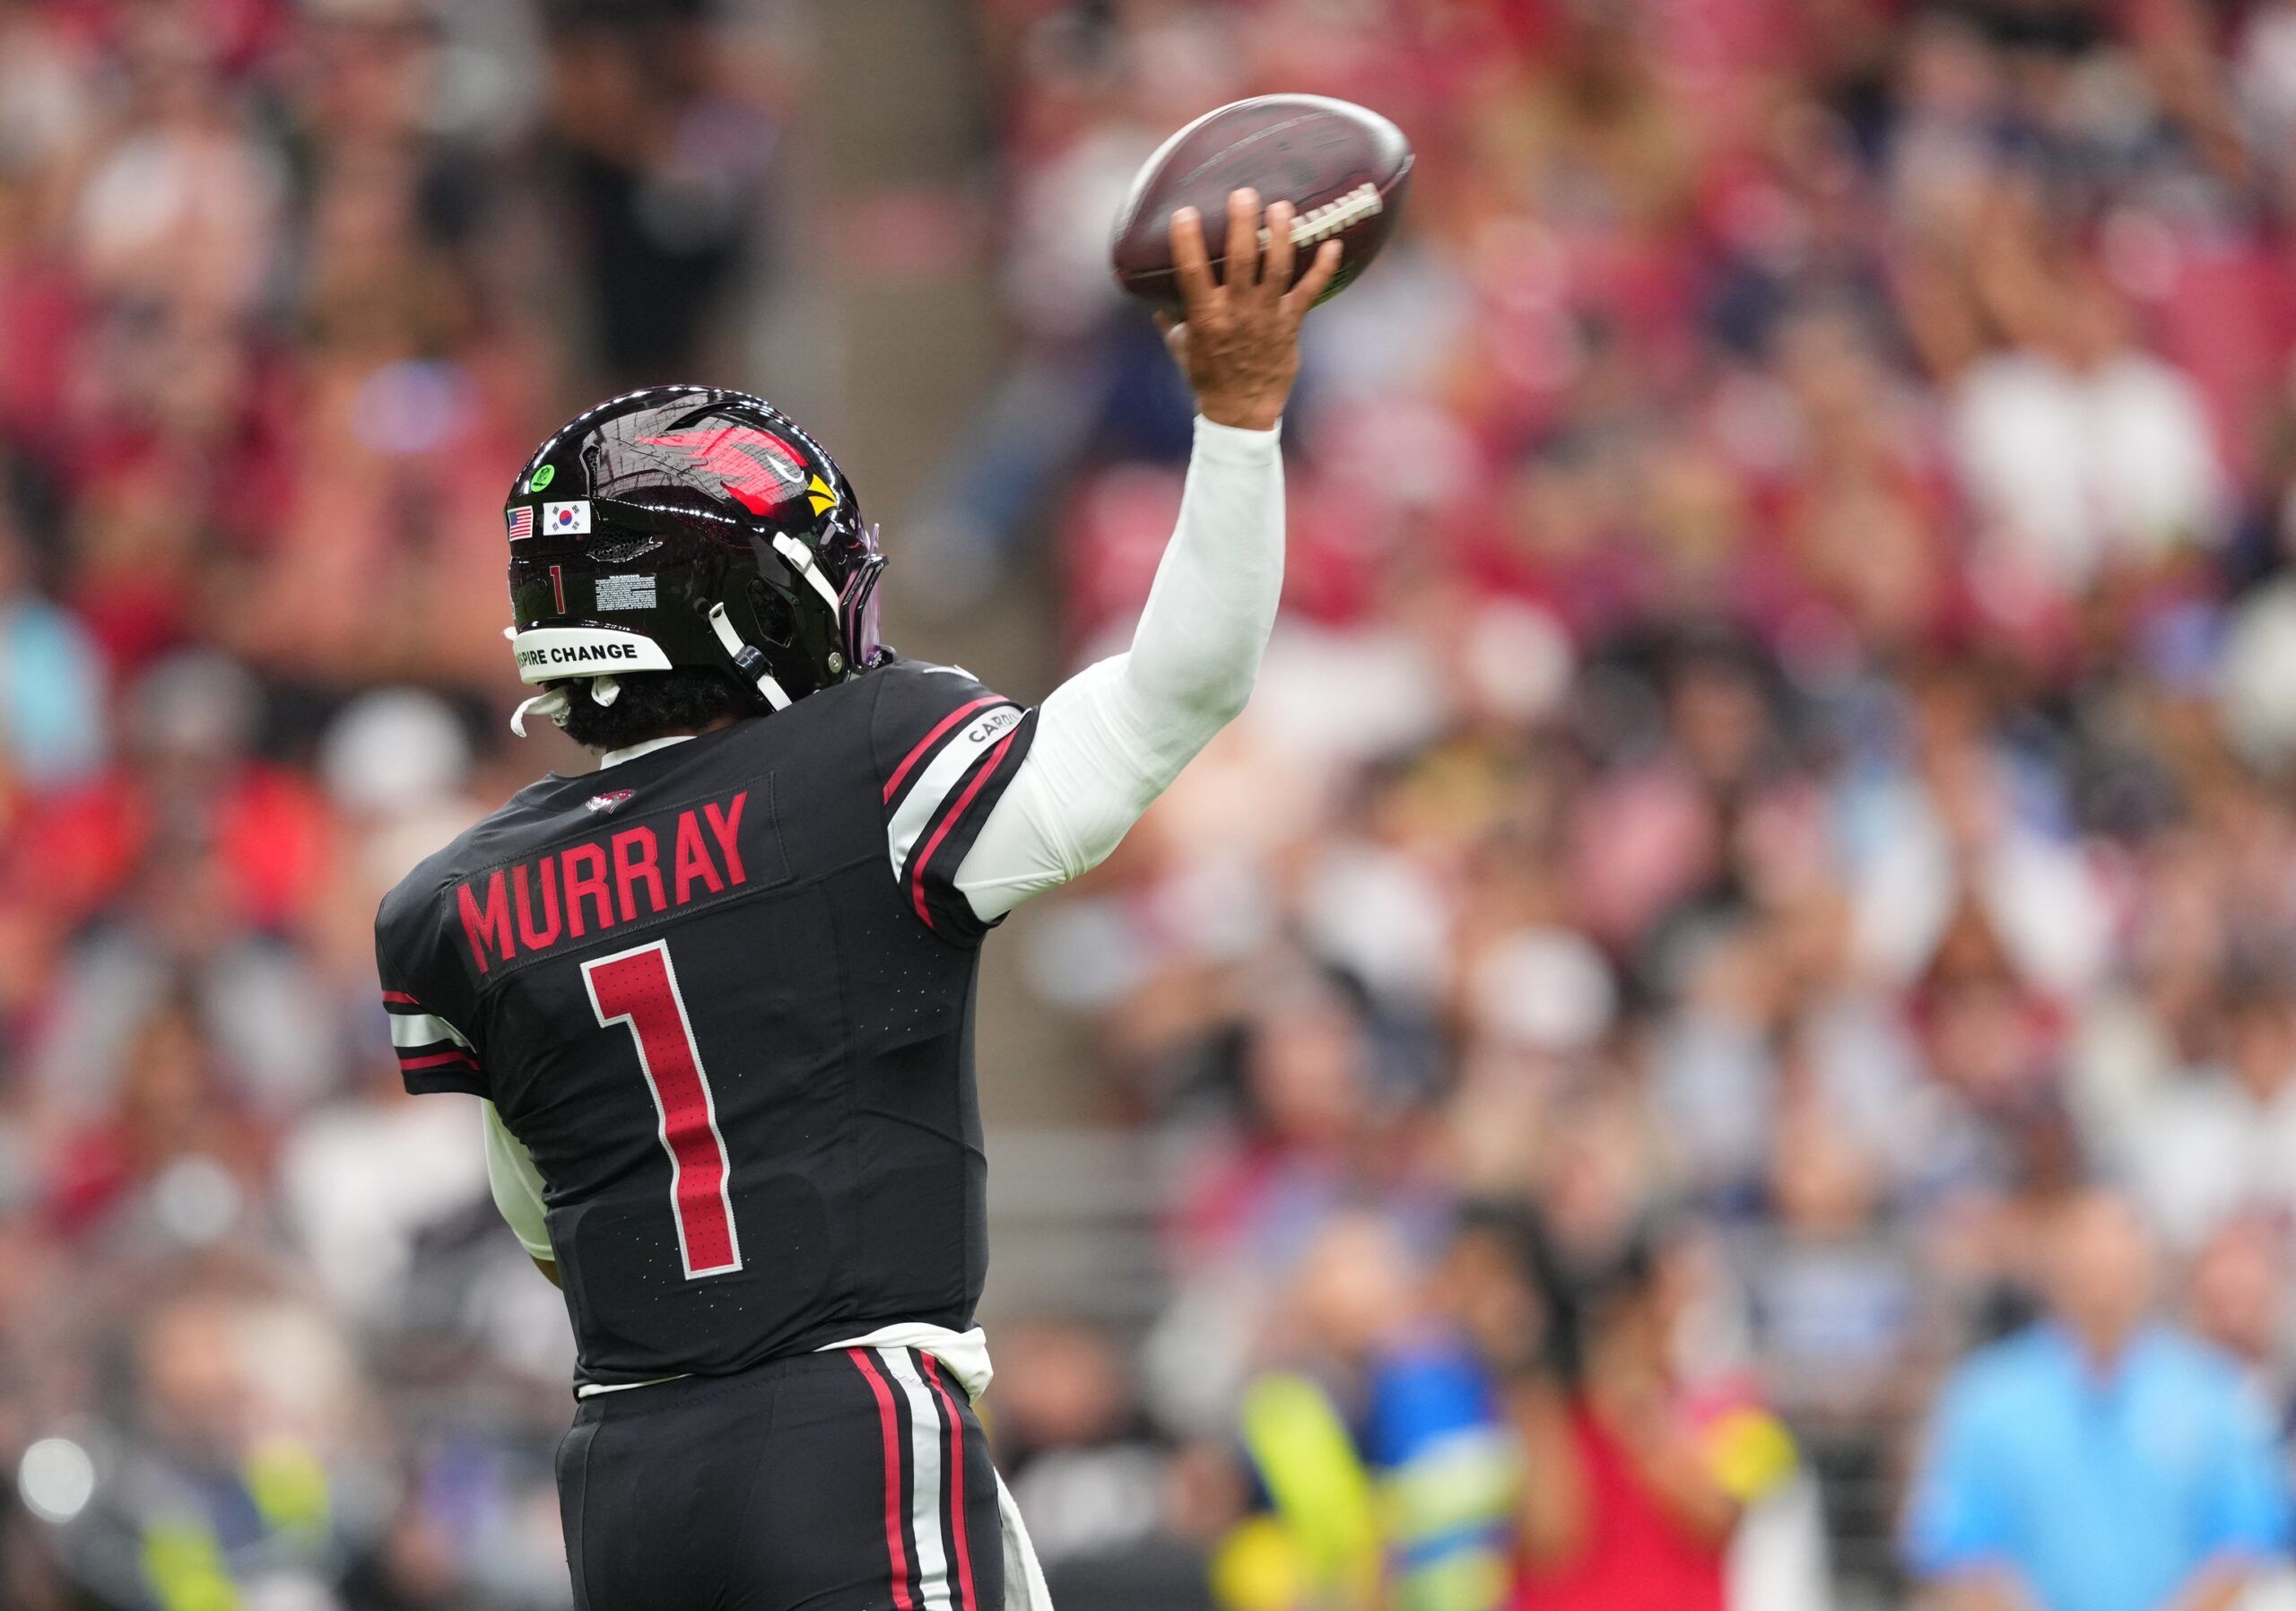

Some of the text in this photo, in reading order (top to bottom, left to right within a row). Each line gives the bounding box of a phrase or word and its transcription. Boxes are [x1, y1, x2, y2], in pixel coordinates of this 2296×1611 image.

[550, 565, 566, 614] 1
[551, 644, 638, 663] CHANGE
[457, 791, 748, 974] MURRAY
[580, 938, 743, 1280] 1
